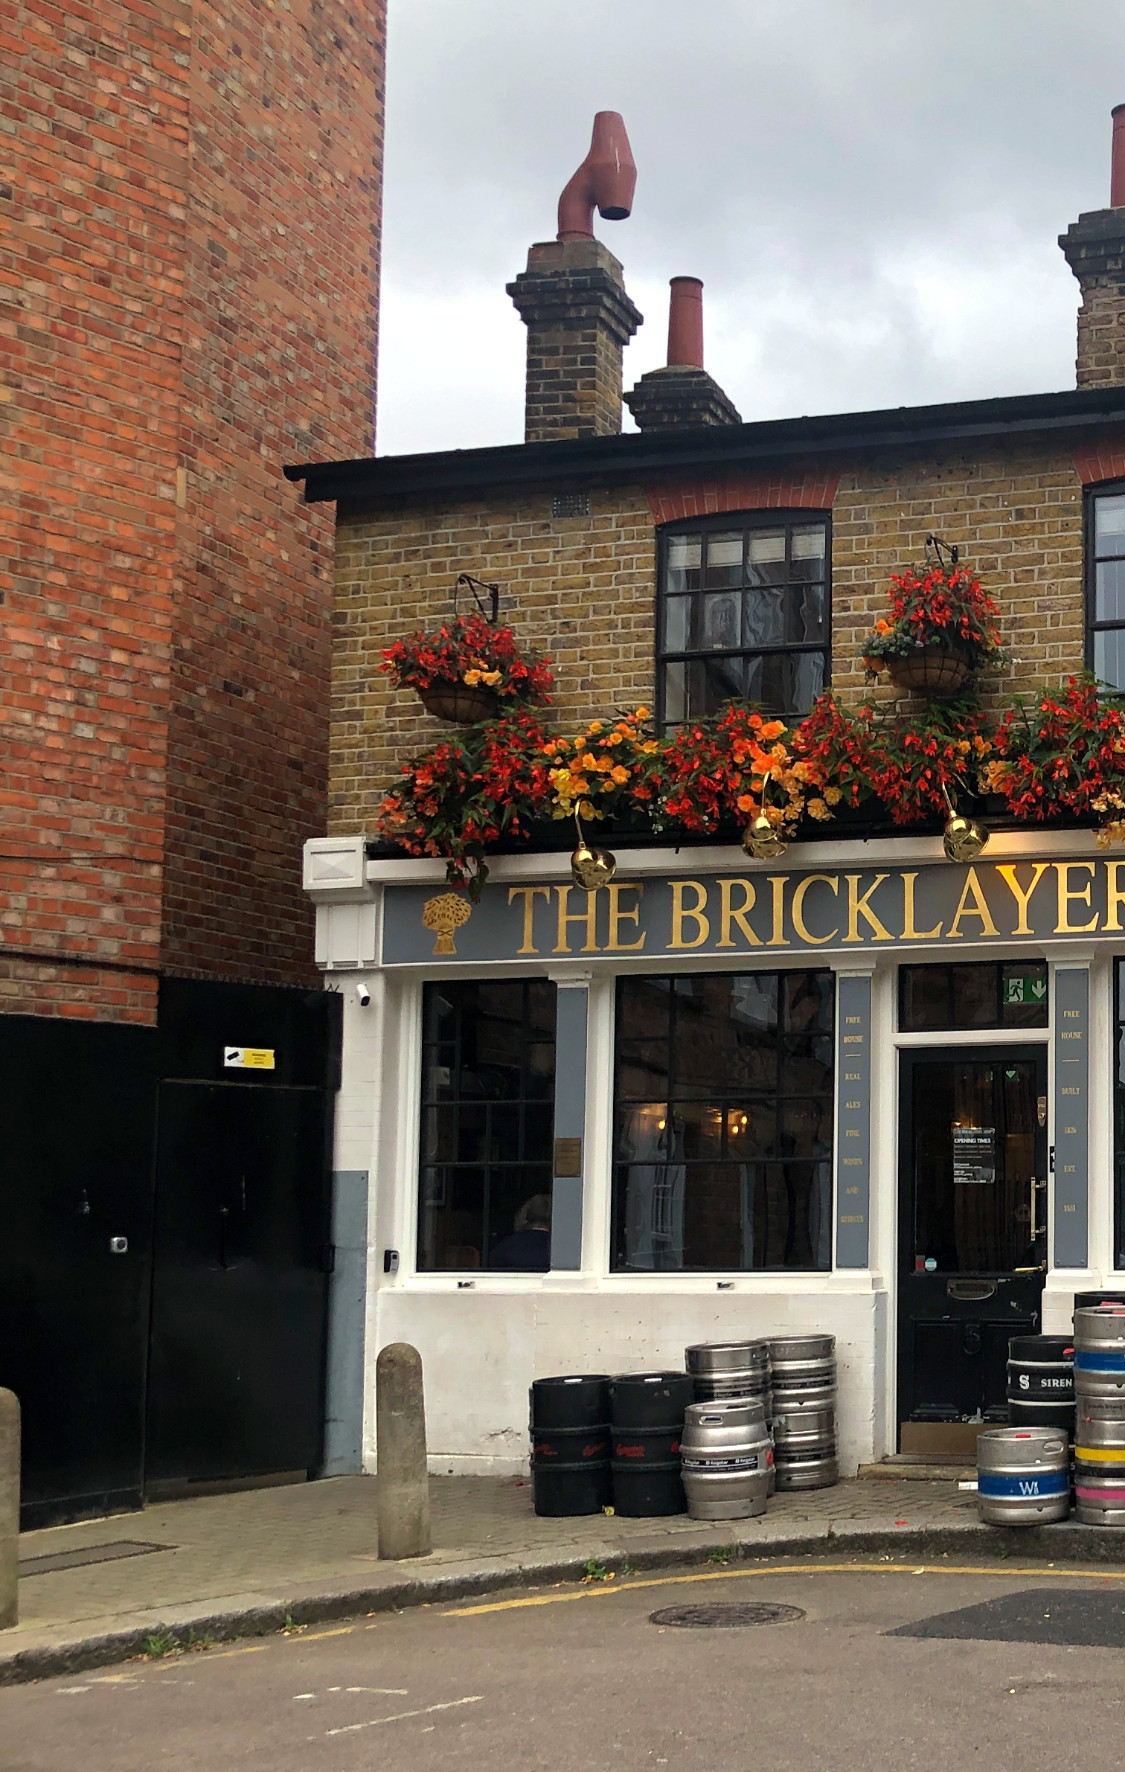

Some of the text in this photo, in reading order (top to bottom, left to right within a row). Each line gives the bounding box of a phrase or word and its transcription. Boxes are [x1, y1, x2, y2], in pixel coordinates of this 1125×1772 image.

[508, 882, 646, 953] THE
[1064, 1010, 1080, 1018] FREE
[1019, 1374, 1072, 1390] S SIREN
